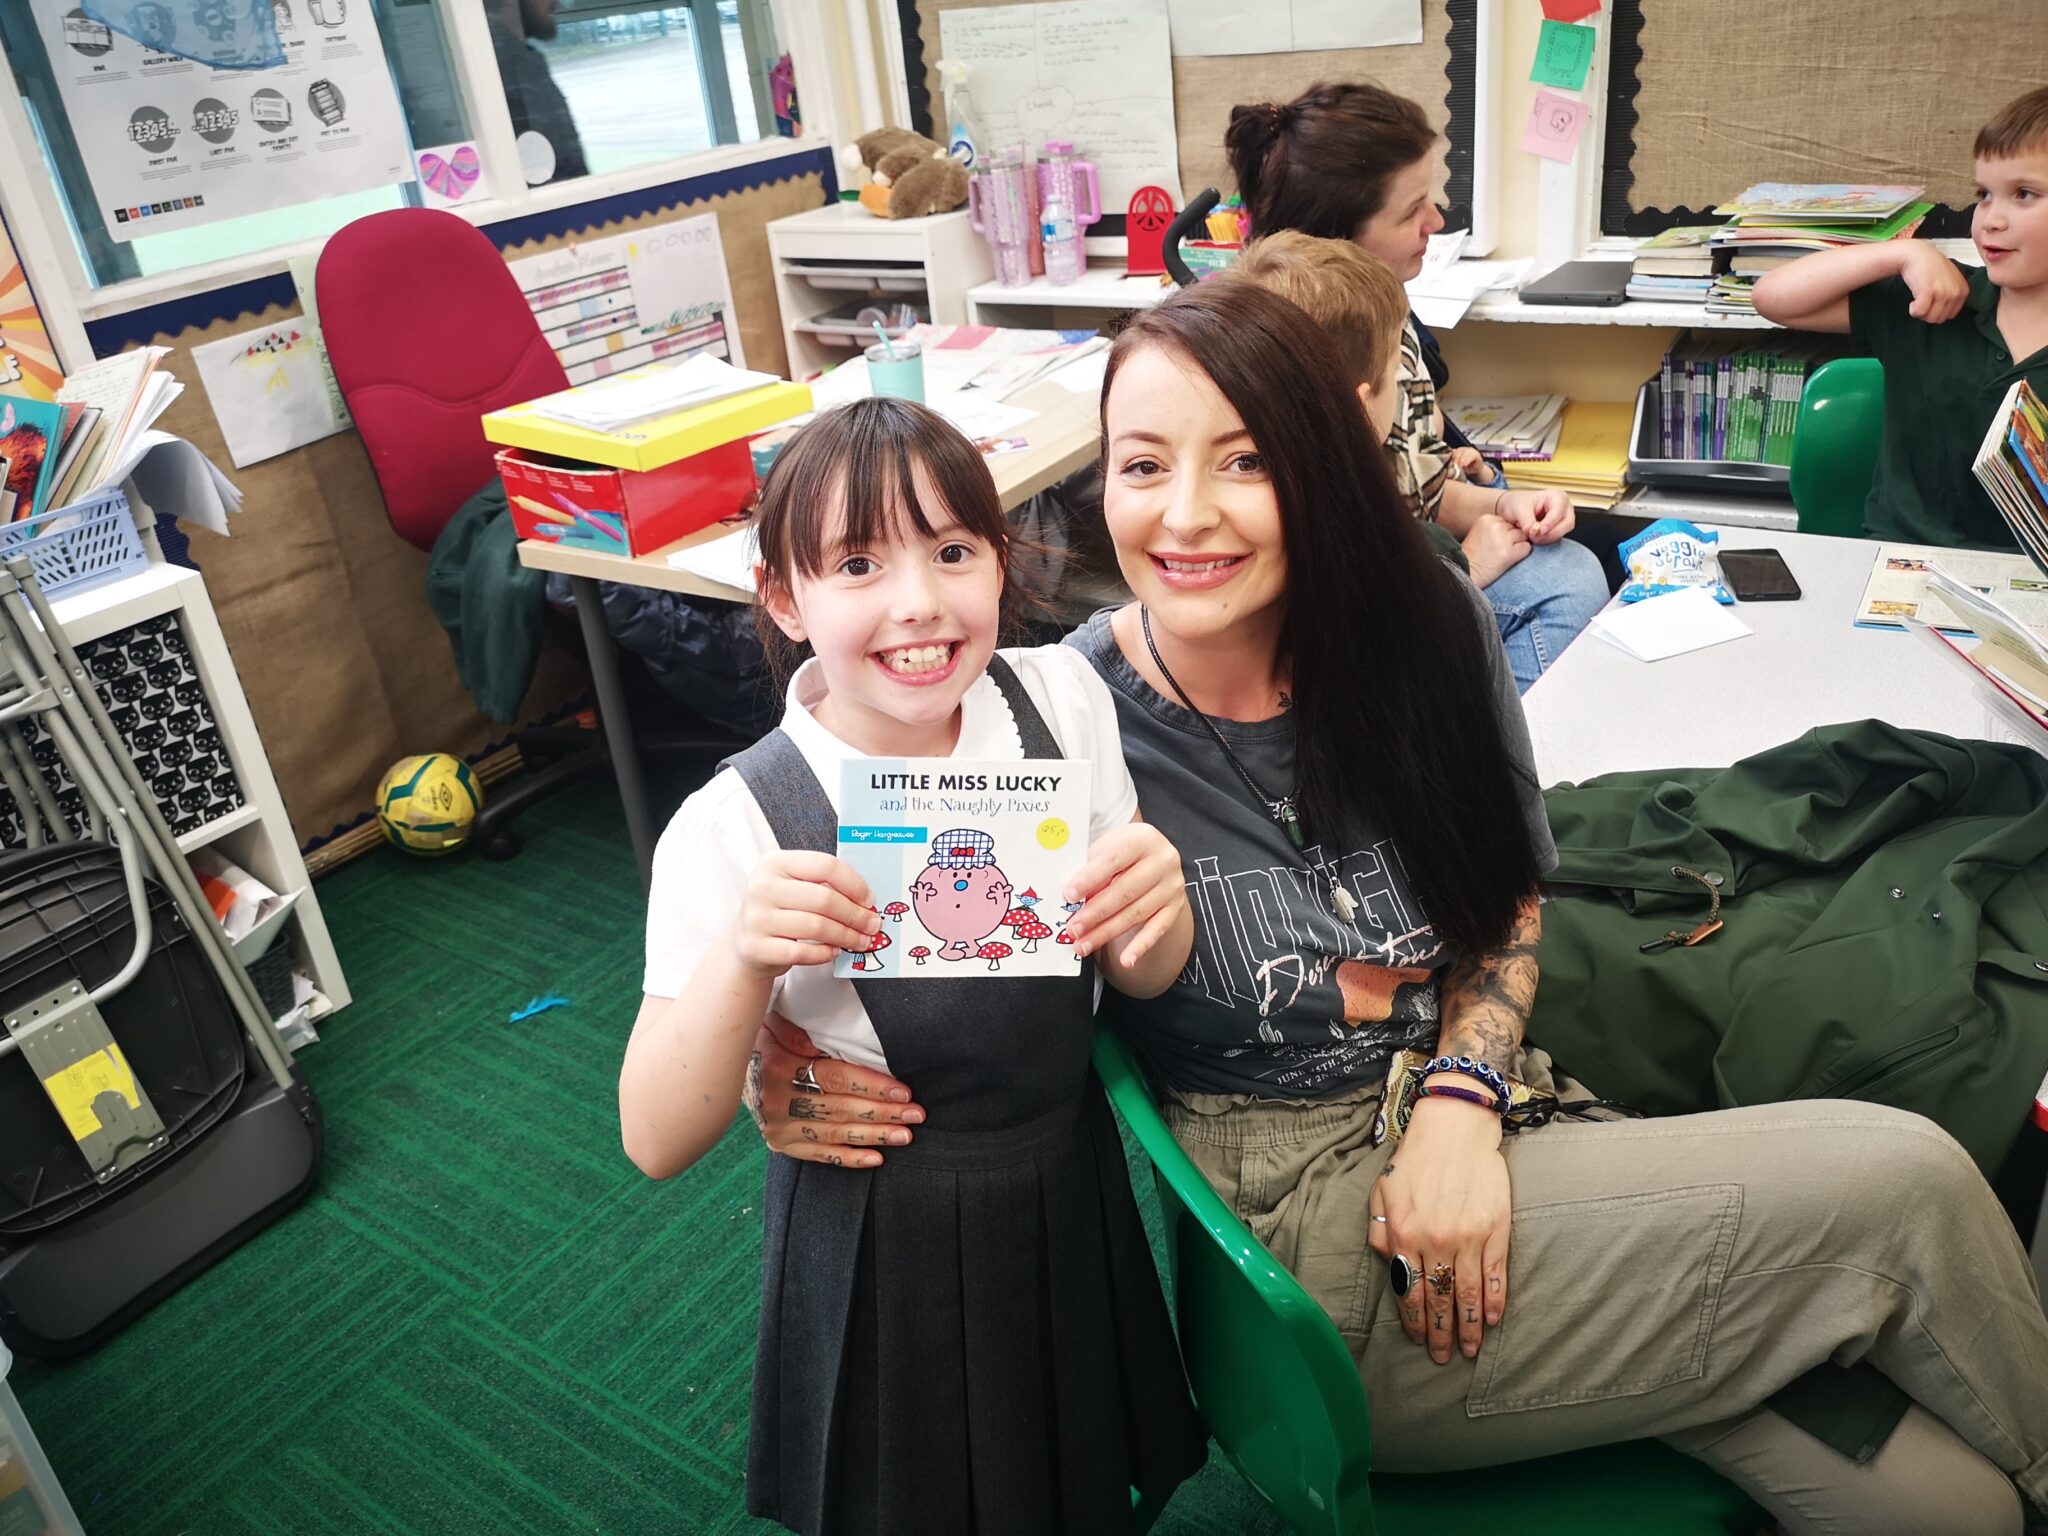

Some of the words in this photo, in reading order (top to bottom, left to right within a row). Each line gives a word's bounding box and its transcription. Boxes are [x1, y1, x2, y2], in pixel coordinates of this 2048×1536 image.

[1650, 541, 1706, 559] veggie
[871, 774, 930, 790] LITTLE
[938, 774, 988, 791] MISS
[996, 776, 1062, 792] LUCKY
[879, 796, 907, 811] and
[912, 796, 935, 811] the
[940, 797, 1002, 817] Naughty
[1007, 798, 1050, 813] Pixies
[851, 829, 873, 841] Roger
